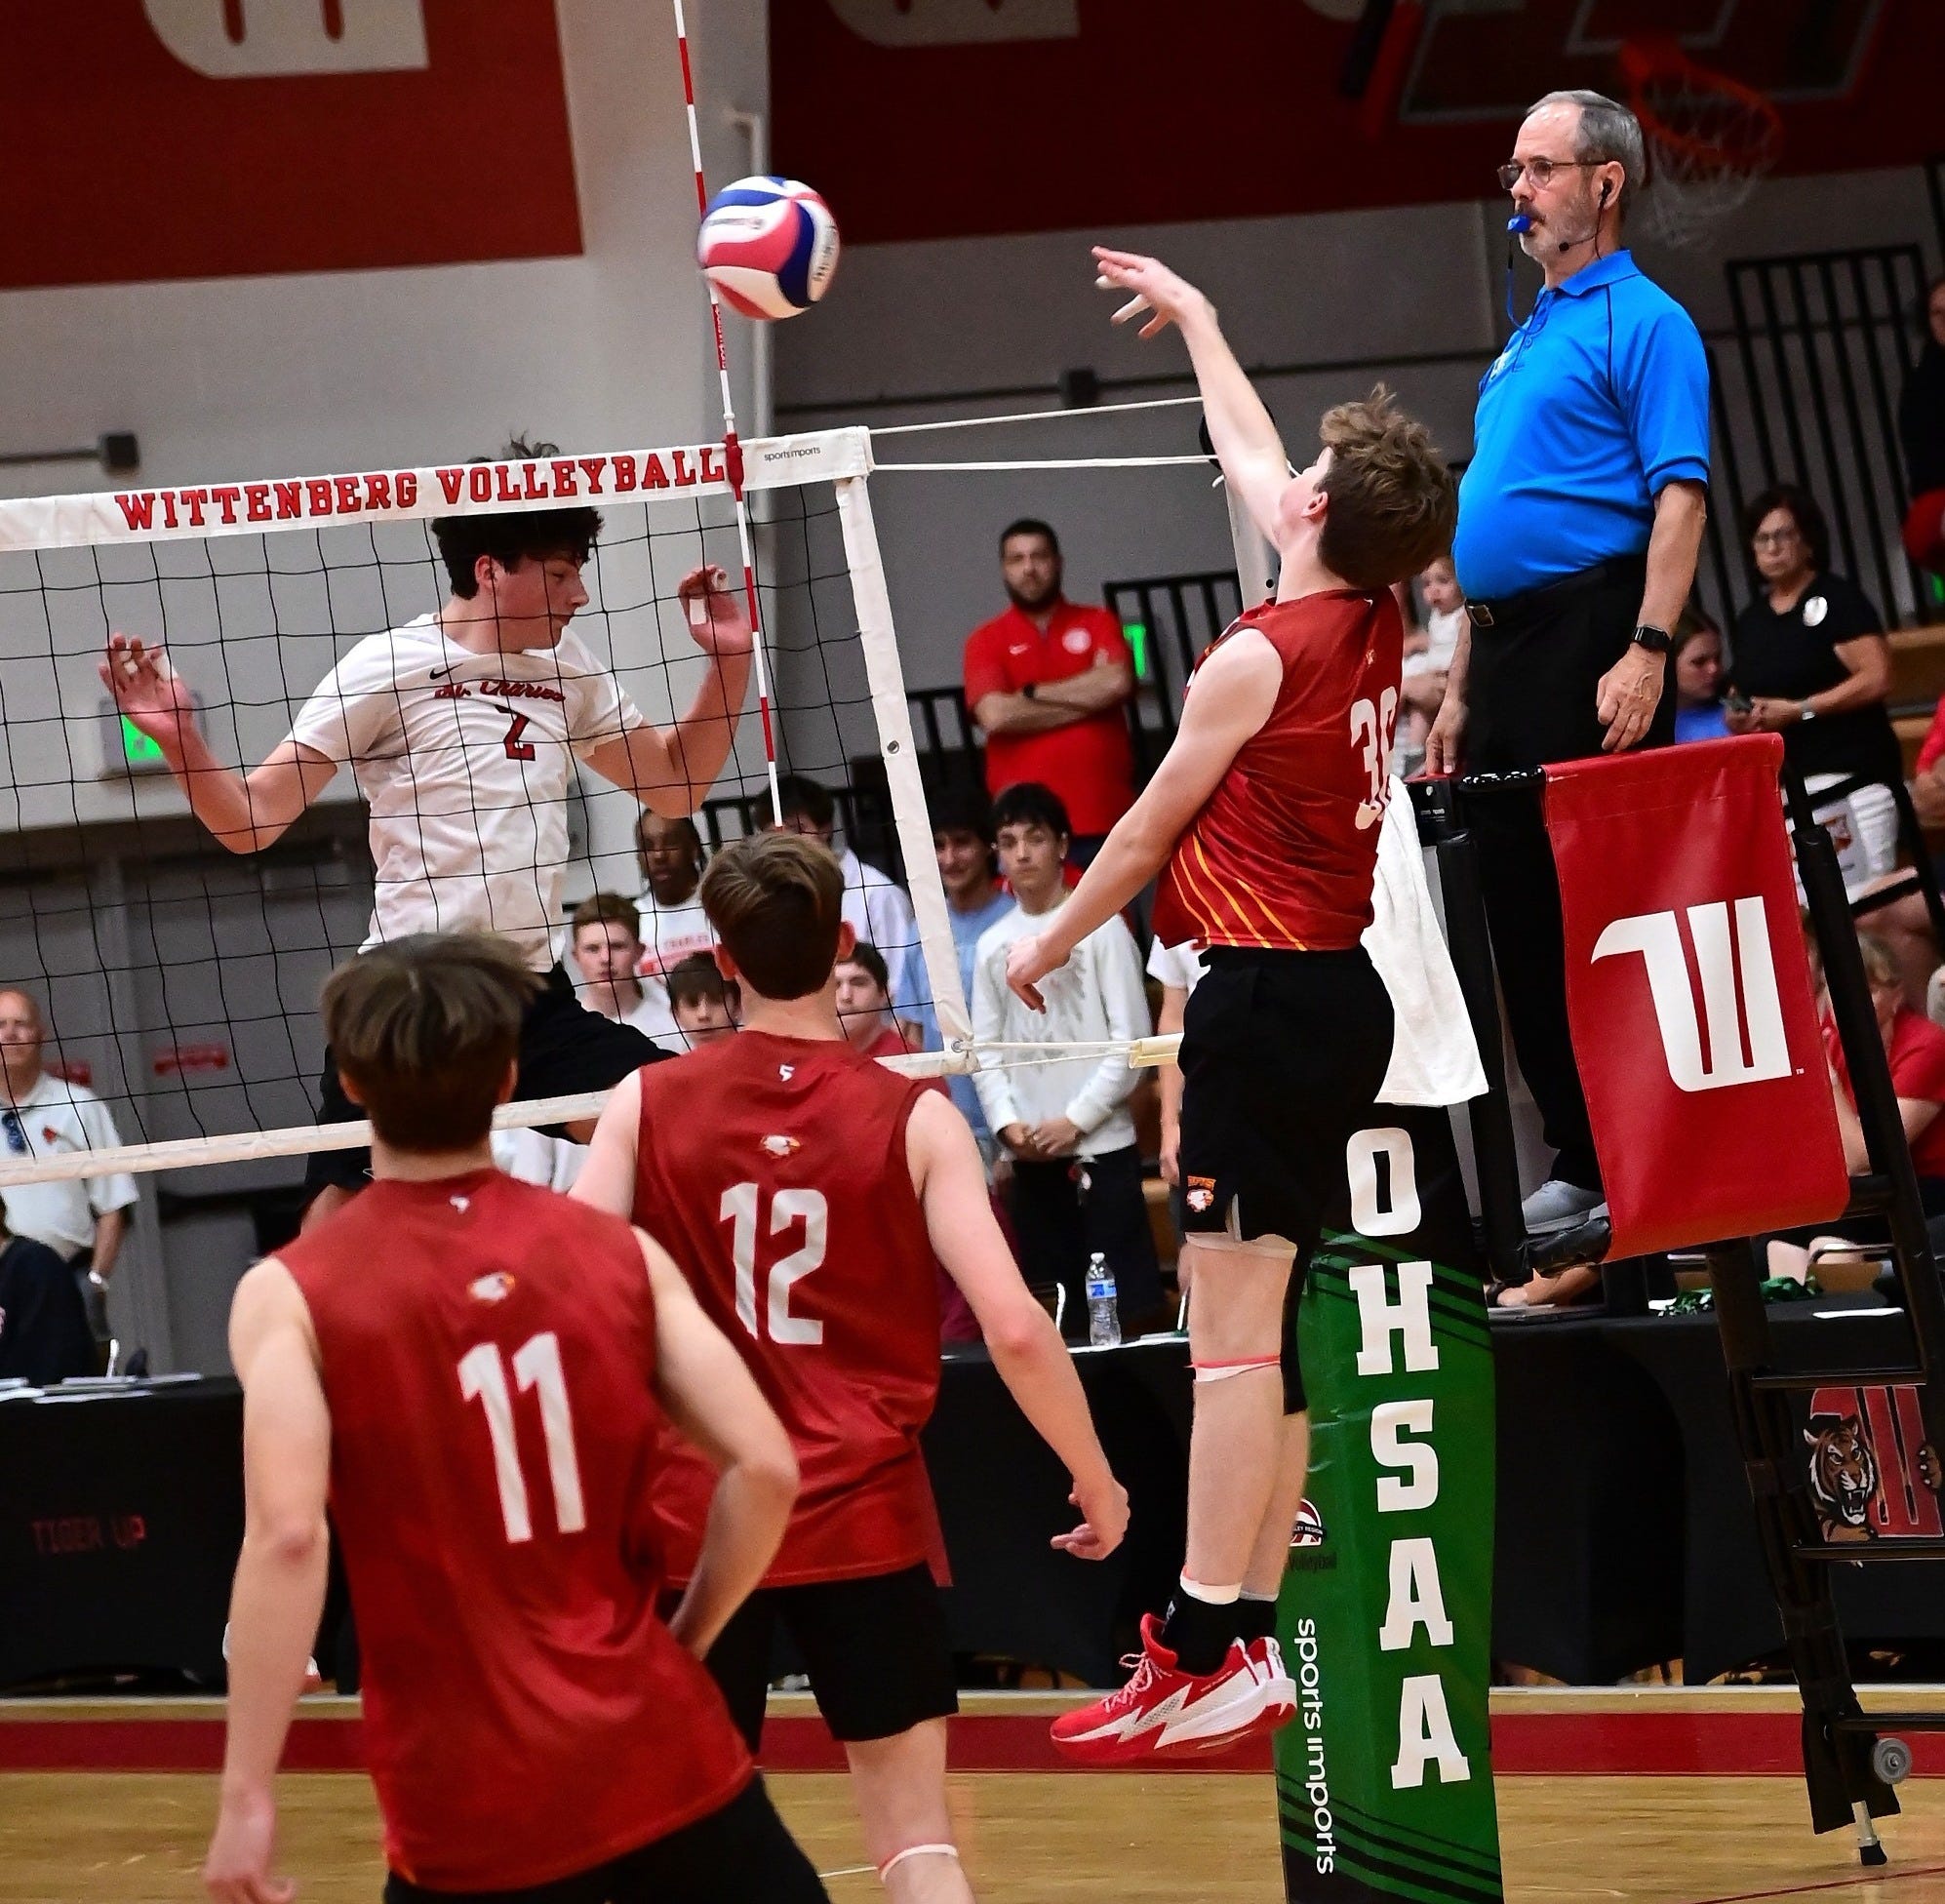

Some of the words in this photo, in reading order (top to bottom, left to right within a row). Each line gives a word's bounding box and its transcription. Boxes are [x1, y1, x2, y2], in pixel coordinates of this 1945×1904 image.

[114, 472, 417, 531] WITTENBERG
[435, 448, 726, 505] VOLLEYBALL
[764, 451, 790, 462] sports
[495, 703, 536, 762] 2
[720, 1182, 828, 1346] 12
[456, 1330, 586, 1544] 11
[1346, 1127, 1471, 1791] OHSAA
[1294, 1618, 1323, 1730] sports
[1305, 1737, 1336, 1875] imports
